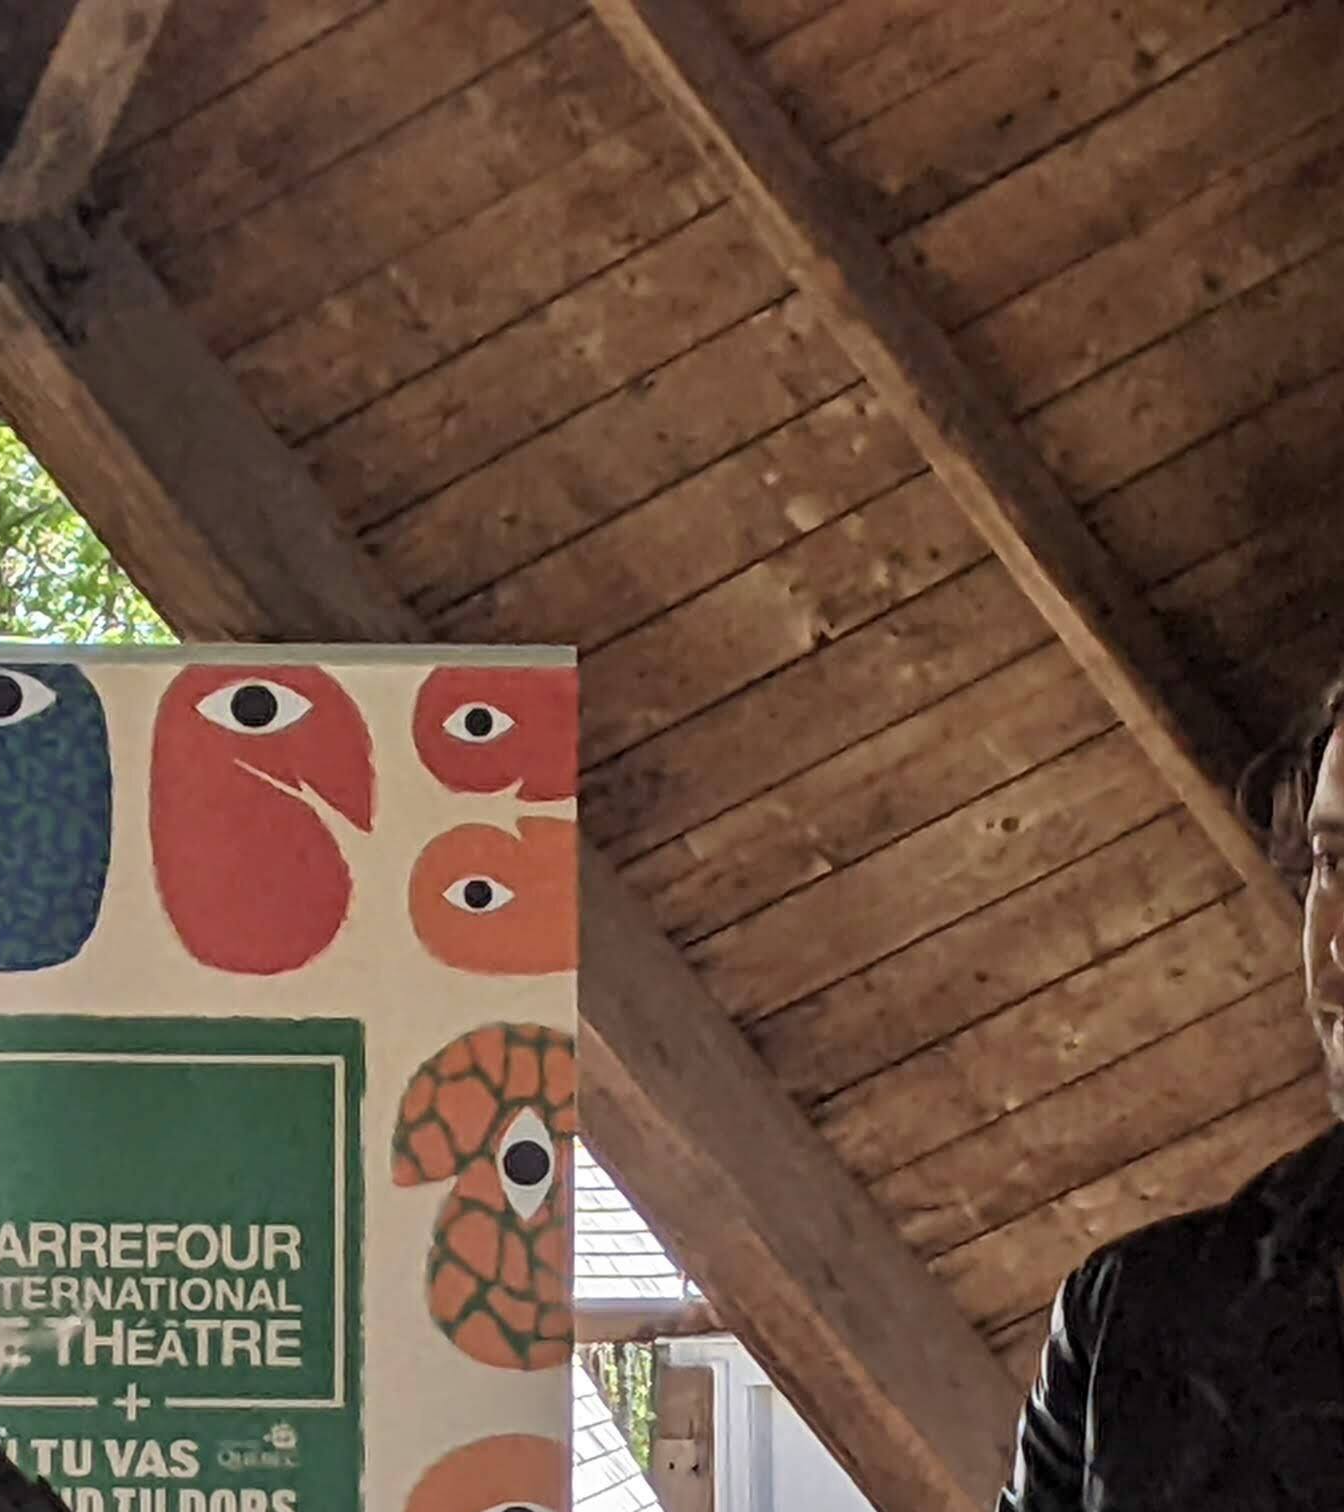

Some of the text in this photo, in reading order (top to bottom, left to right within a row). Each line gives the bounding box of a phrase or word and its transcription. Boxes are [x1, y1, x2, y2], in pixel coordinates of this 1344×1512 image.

[43, 1315, 303, 1367] THÉÂTRE
[30, 1438, 93, 1477] TU
[104, 1438, 201, 1478] VAS
